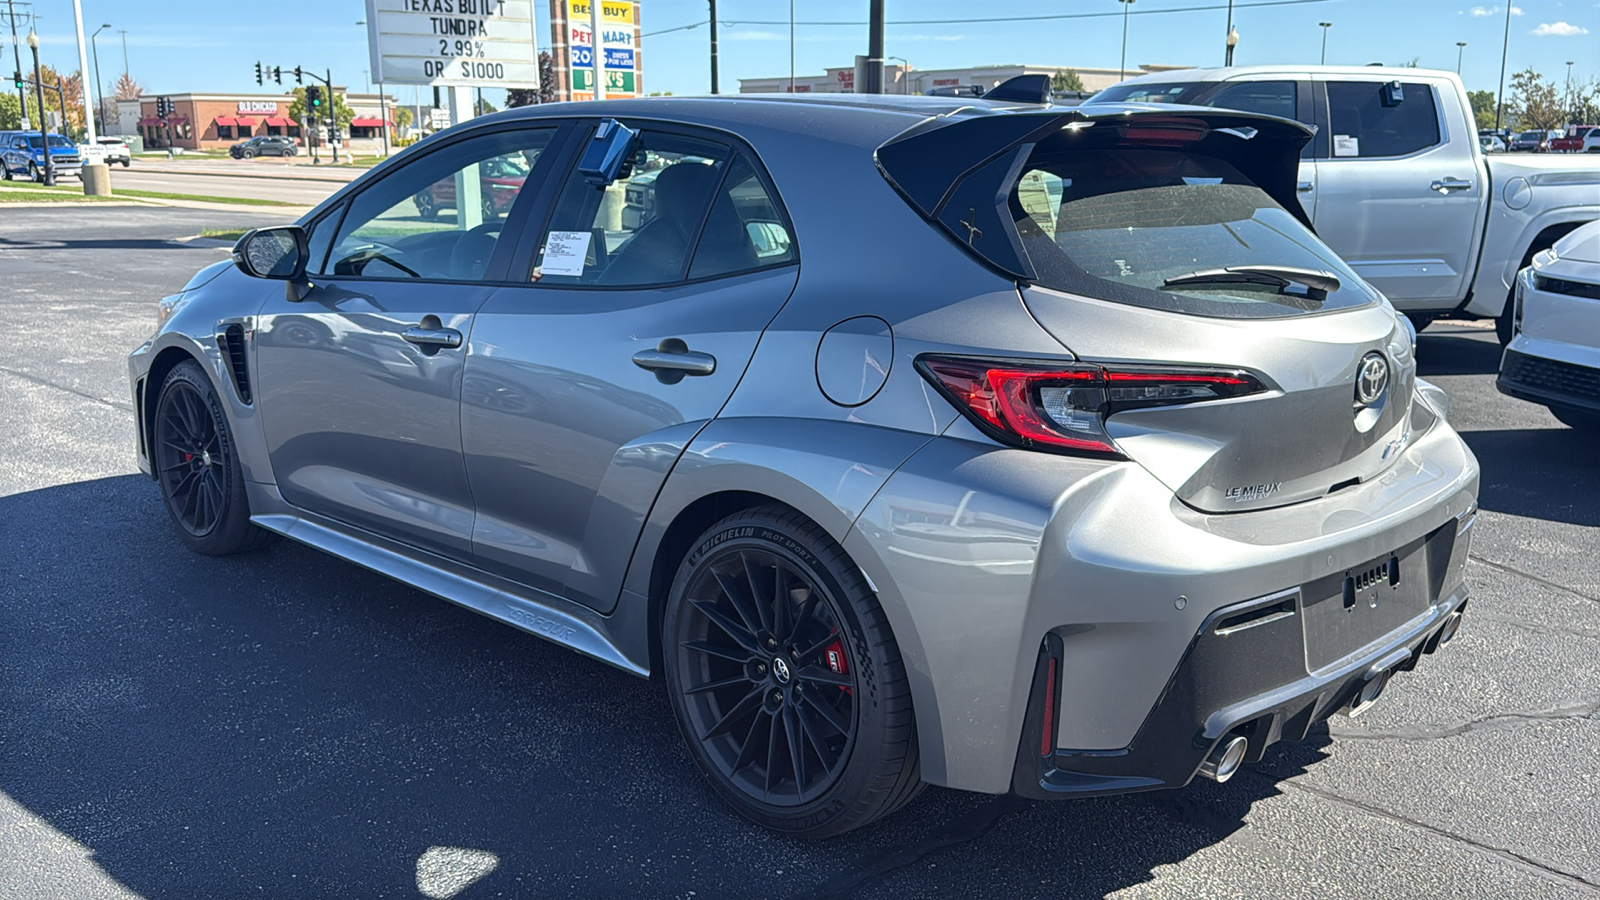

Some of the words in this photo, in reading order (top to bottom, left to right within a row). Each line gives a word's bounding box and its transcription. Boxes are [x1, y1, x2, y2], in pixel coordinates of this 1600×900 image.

[459, 0, 506, 17] BUILT
[603, 7, 628, 17] BUY
[430, 17, 488, 37] TUNDRA
[572, 28, 632, 44] PETMART
[439, 39, 485, 58] 2.99%
[424, 60, 445, 78] OR
[584, 70, 624, 87] DK'S
[1225, 487, 1241, 499] LE
[1242, 482, 1282, 496] MIEUX
[701, 527, 755, 554] MICHELIN
[761, 530, 784, 543] PILOT
[784, 539, 812, 560] SPORT
